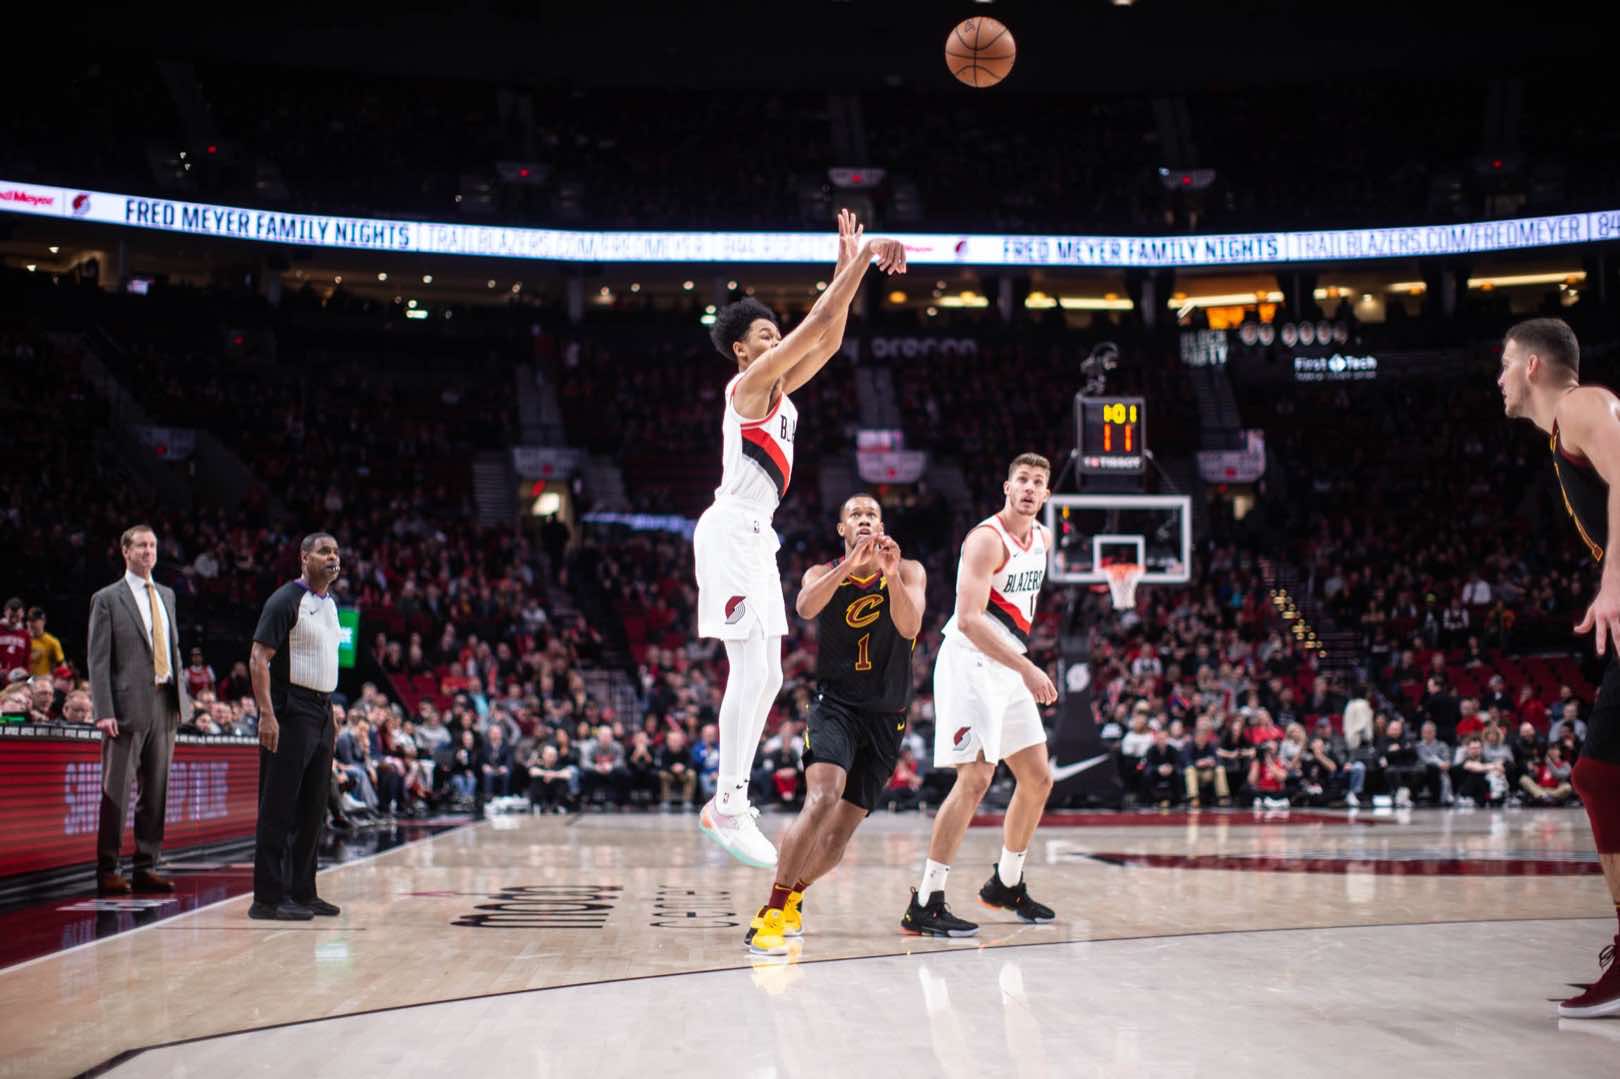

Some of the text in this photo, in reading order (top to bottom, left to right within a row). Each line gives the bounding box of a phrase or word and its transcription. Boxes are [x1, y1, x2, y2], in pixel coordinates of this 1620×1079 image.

[125, 199, 410, 246] FRED MEYER FAMILY NIGHTS
[1003, 238, 1278, 260] FRED MEYER FAMILY NIGHTS
[1294, 355, 1378, 371] First Tech
[1003, 570, 1043, 593] BLAZERS
[855, 632, 872, 671] 1
